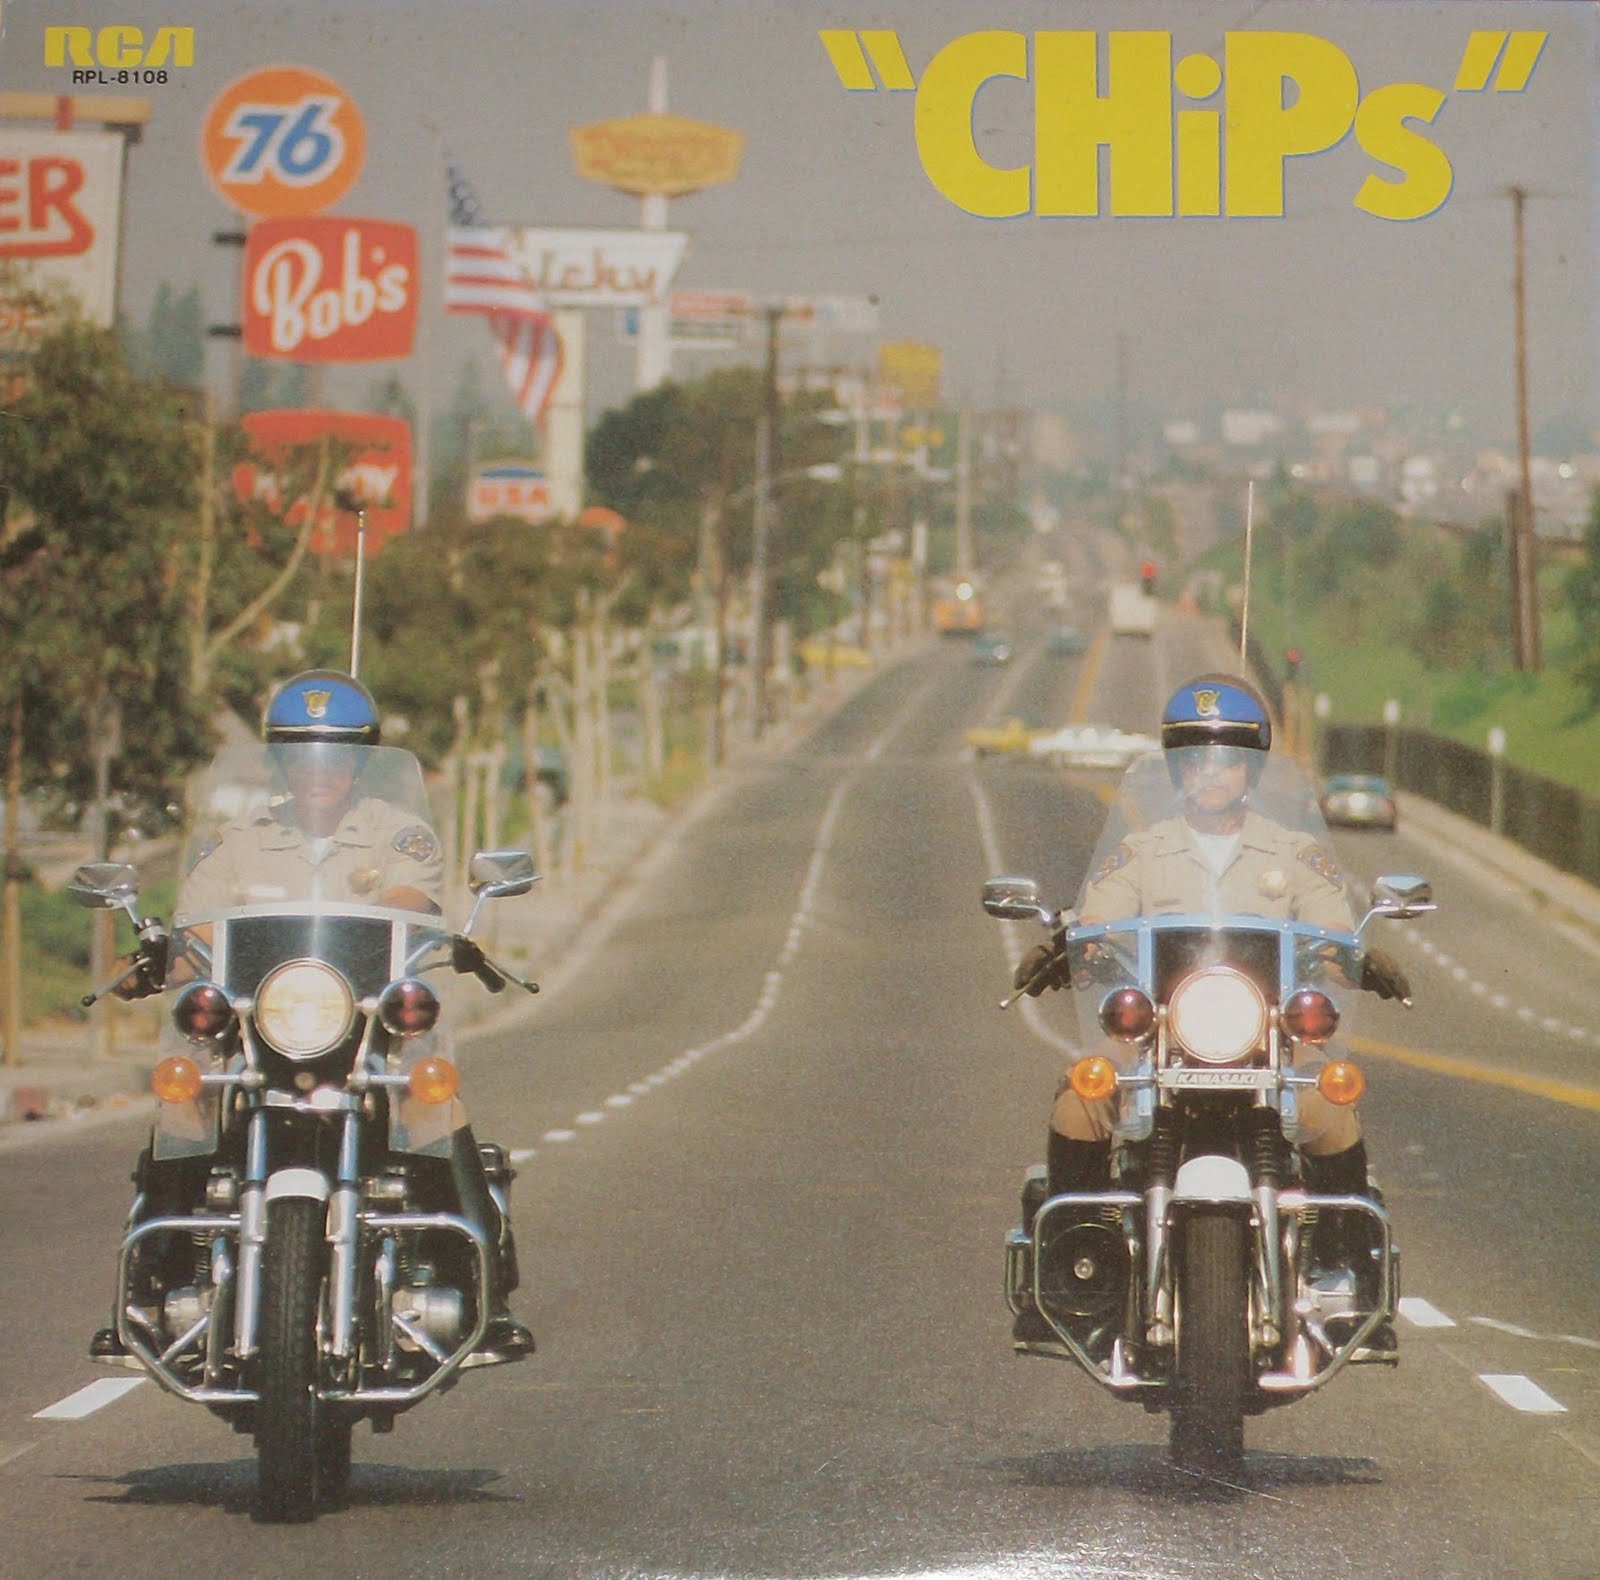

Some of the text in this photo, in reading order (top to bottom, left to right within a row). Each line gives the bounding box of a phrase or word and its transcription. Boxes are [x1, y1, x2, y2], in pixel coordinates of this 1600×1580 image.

[222, 96, 344, 187] 76
[254, 229, 409, 352] Bob's
[1176, 1072, 1257, 1085] KAWASAKI
